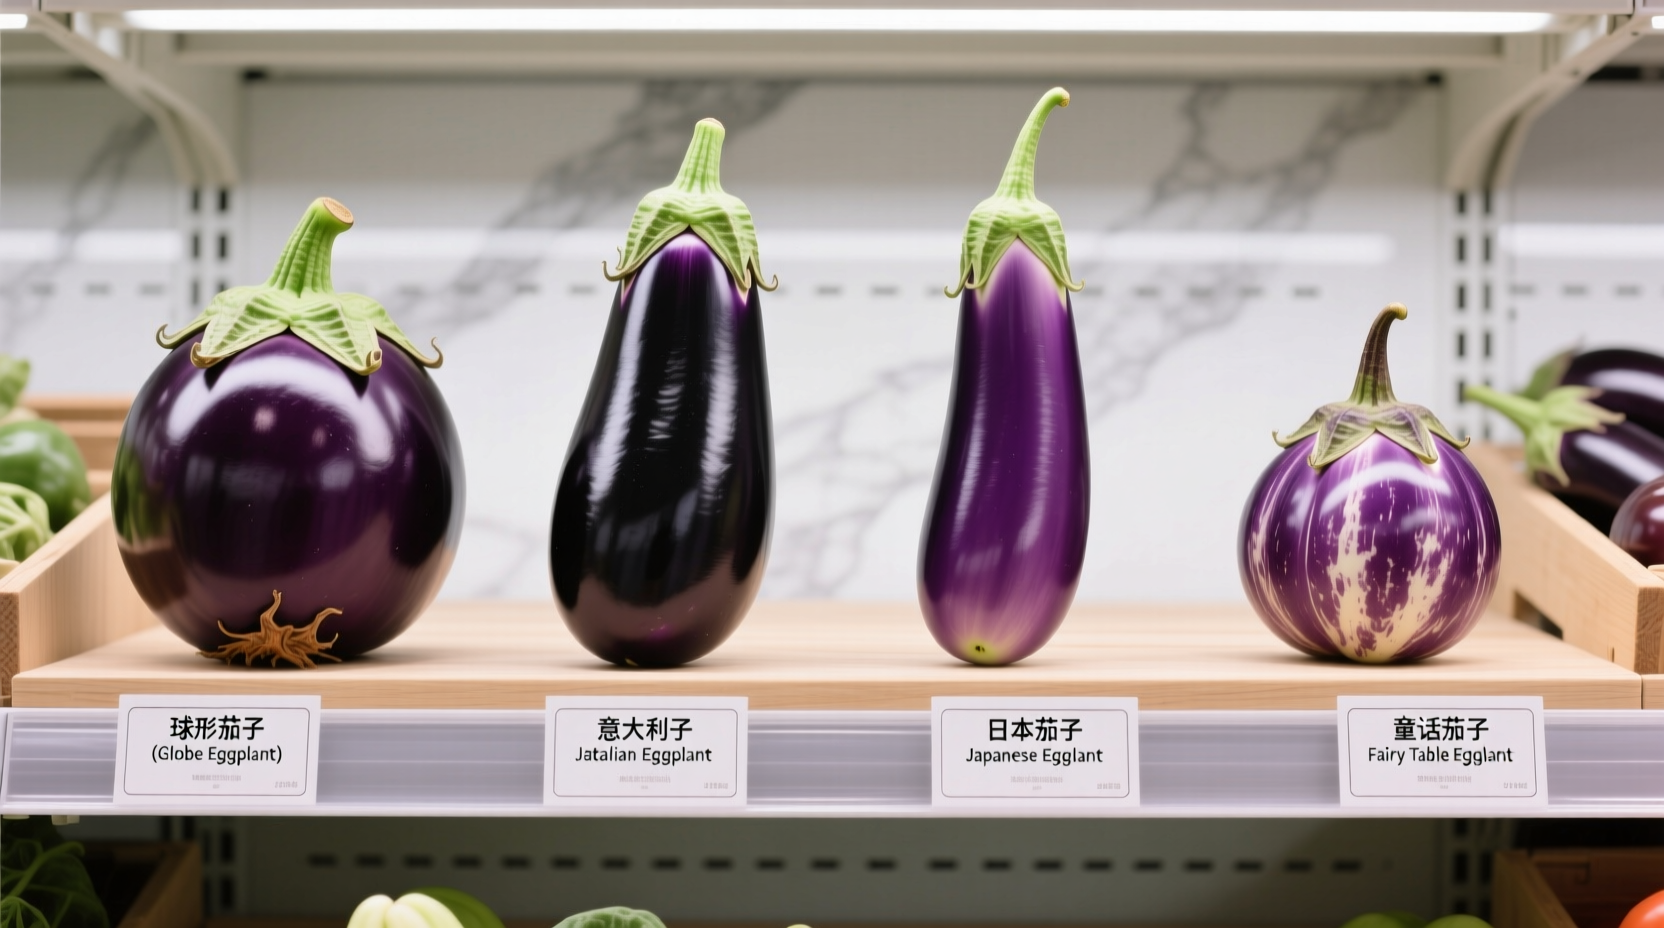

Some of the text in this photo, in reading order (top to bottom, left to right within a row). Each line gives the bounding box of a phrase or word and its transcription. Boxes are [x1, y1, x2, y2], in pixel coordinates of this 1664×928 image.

[170, 715, 264, 740] 球形茄子
[597, 716, 692, 741] 意大利子
[989, 717, 1082, 741] 日本茄子
[1394, 715, 1488, 741] 童话茄子
[152, 745, 282, 766] (Globe Eggplant)
[642, 747, 712, 766] Eggplant
[966, 747, 1104, 766] Japanese Egglant
[1368, 746, 1513, 766] Fairy Table Egglant
